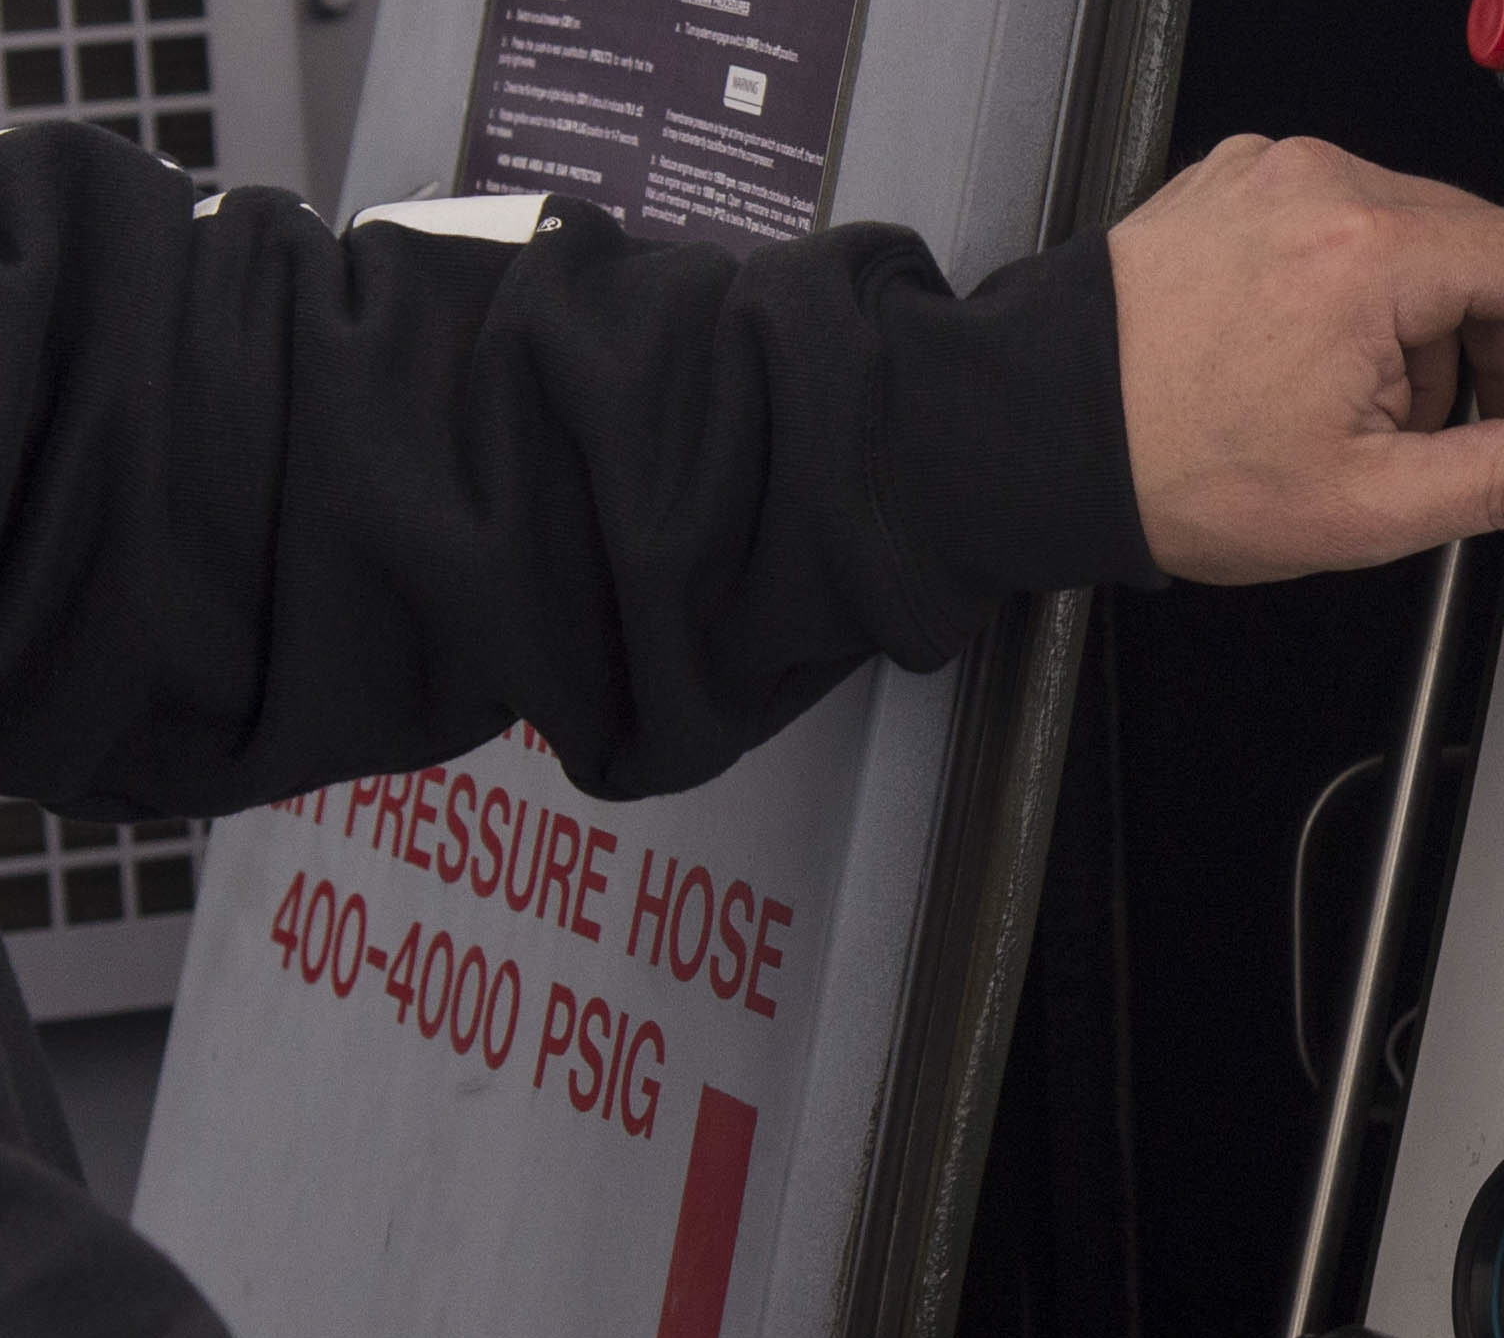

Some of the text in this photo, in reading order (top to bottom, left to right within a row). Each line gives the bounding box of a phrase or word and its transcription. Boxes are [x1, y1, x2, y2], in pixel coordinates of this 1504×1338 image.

[271, 870, 666, 1141] 400-4000 PSIG
[345, 767, 794, 1019] PRESSURE HOSE
